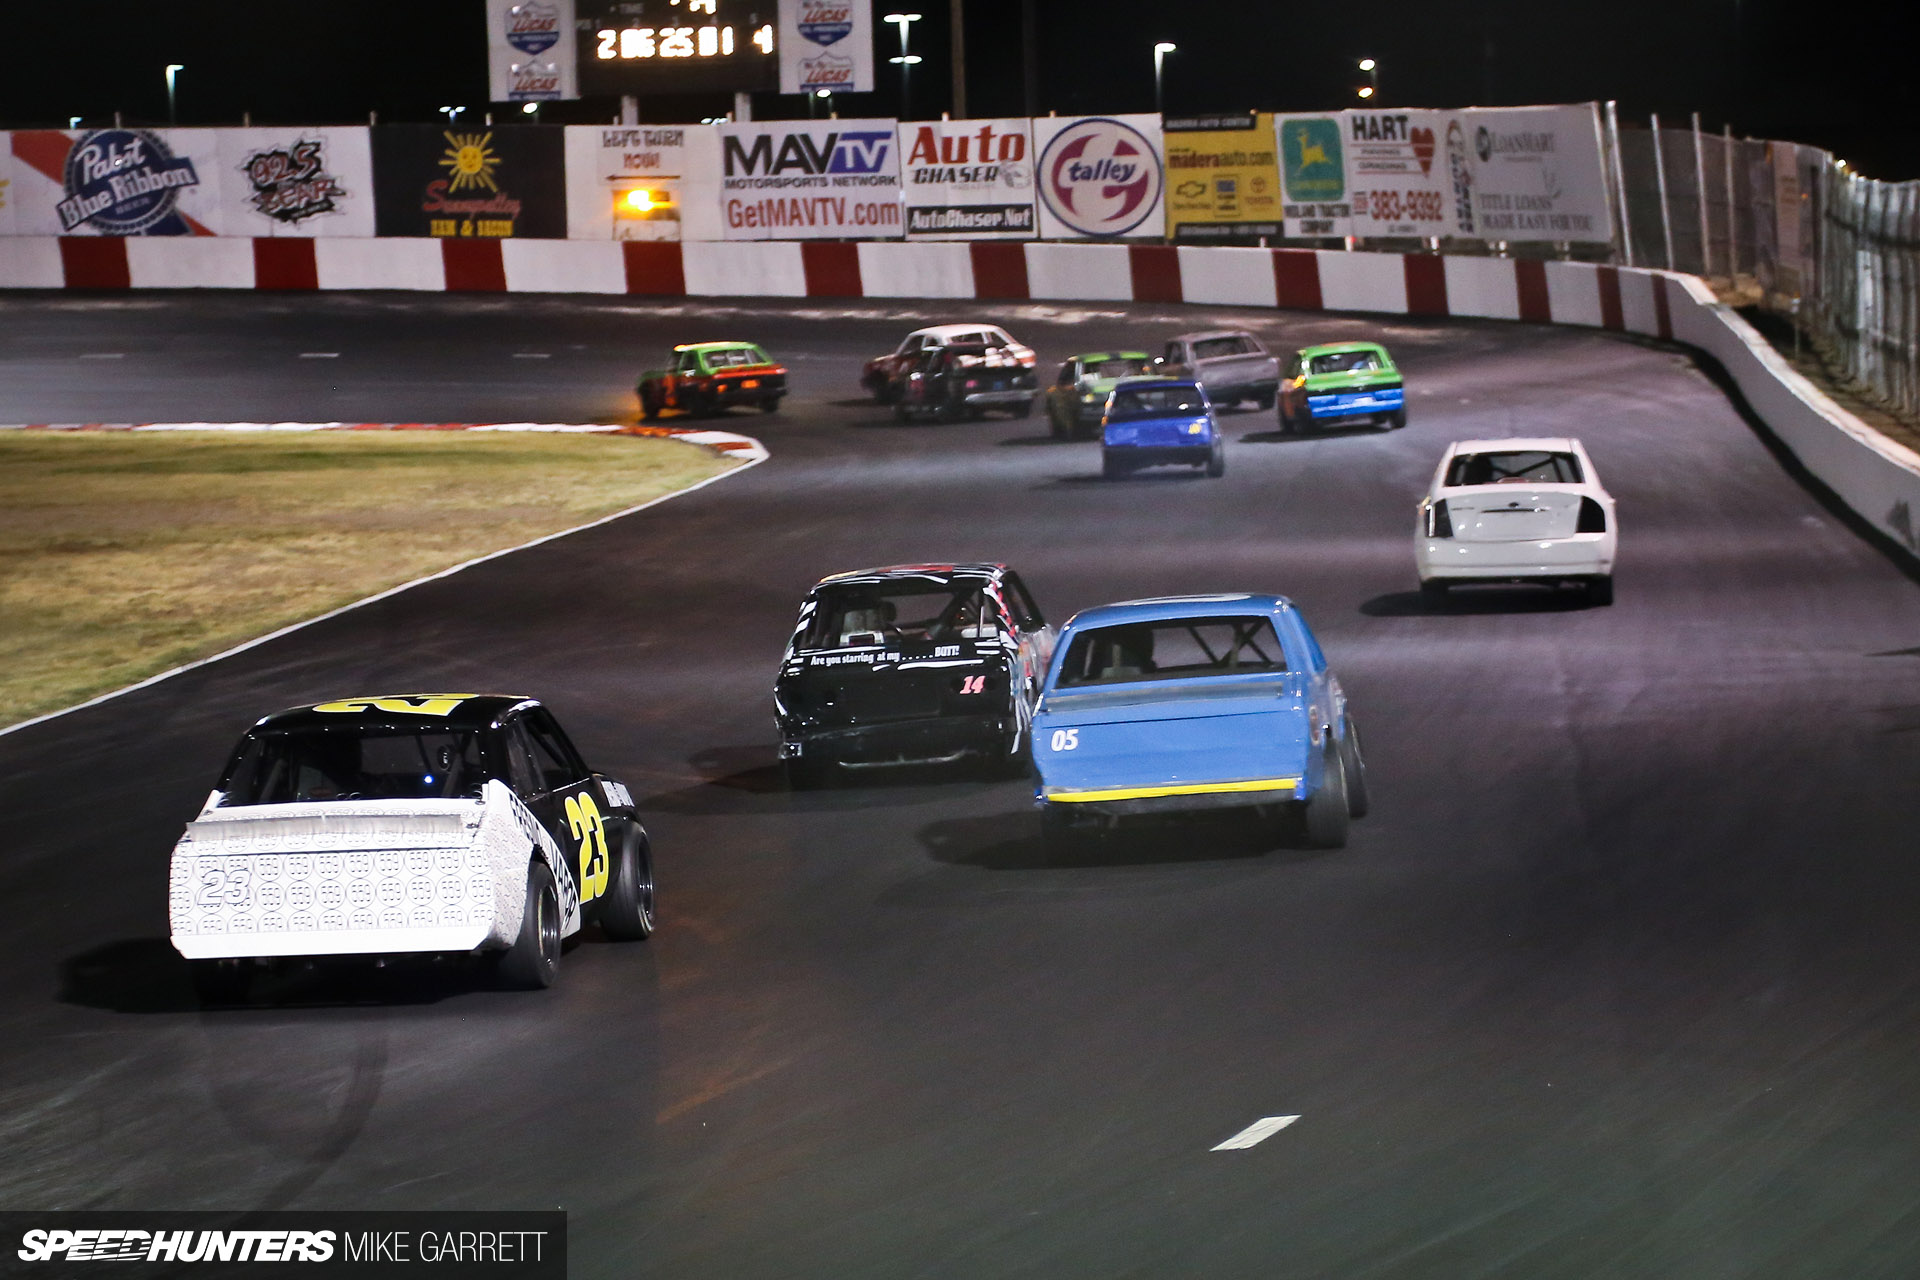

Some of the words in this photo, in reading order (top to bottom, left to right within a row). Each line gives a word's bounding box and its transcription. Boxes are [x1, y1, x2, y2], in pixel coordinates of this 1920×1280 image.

[512, 17, 557, 32] LUCAS
[803, 8, 850, 22] LUCAS
[514, 77, 559, 91] LUCAS
[806, 68, 852, 83] LUCAS
[1351, 115, 1409, 141] HART
[723, 131, 892, 176] MAVTV
[908, 125, 1025, 165] Auto
[74, 137, 146, 185] Pabst
[250, 143, 321, 187] 92.5
[1068, 159, 1137, 183] talley
[724, 177, 829, 190] MOTORSPORTS
[832, 175, 897, 187] NETWORK
[913, 165, 1000, 184] CHASER
[58, 190, 114, 230] Blue
[108, 166, 195, 203] Ribbon
[728, 196, 899, 230] GetMAVTV.com
[910, 207, 1031, 230] AutoChaser.Net
[811, 656, 825, 666] Are
[826, 657, 841, 666] you
[842, 654, 874, 664] starring
[877, 652, 886, 662] at
[887, 652, 900, 662] my
[959, 675, 986, 695] 14
[1050, 729, 1079, 752] 05
[565, 792, 609, 905] 23
[197, 869, 252, 906] 23
